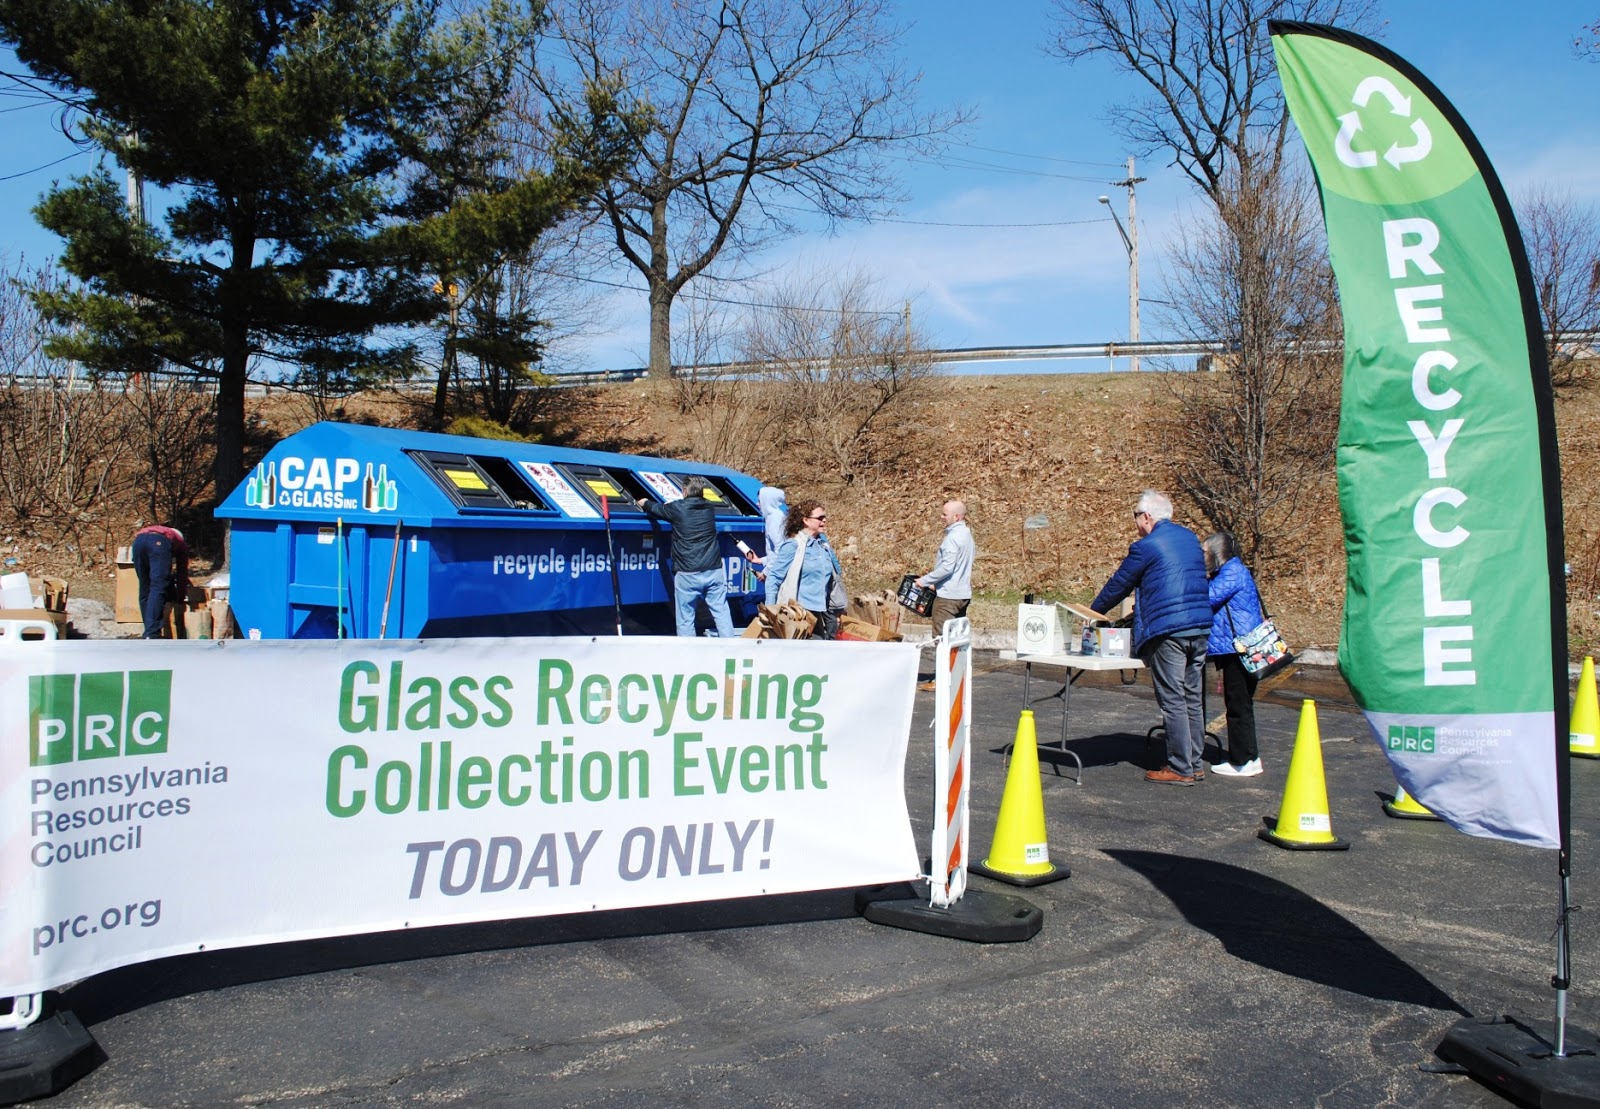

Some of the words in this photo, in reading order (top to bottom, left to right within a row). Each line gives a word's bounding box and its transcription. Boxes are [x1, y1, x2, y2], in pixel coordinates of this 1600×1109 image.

[1382, 217, 1477, 686] RECYCLE
[279, 456, 360, 491] CAP
[292, 490, 344, 509] GLASS
[493, 548, 565, 581] recycle
[619, 547, 660, 571] here!
[338, 660, 513, 733] Glass
[536, 658, 829, 737] Recycling
[38, 711, 163, 756] PRC
[1390, 737, 1433, 751] PRC
[1440, 727, 1512, 740] Pennsylvania
[1440, 737, 1499, 747] Resources
[1440, 745, 1483, 755] Council
[31, 761, 228, 804] Pennsylvania
[325, 736, 649, 818] Collection
[673, 732, 828, 797] Event
[31, 797, 191, 836] Resources
[31, 826, 142, 868] Council
[406, 829, 603, 900] TODAY
[618, 818, 775, 882] ONLY!
[33, 899, 162, 956] prc.org
